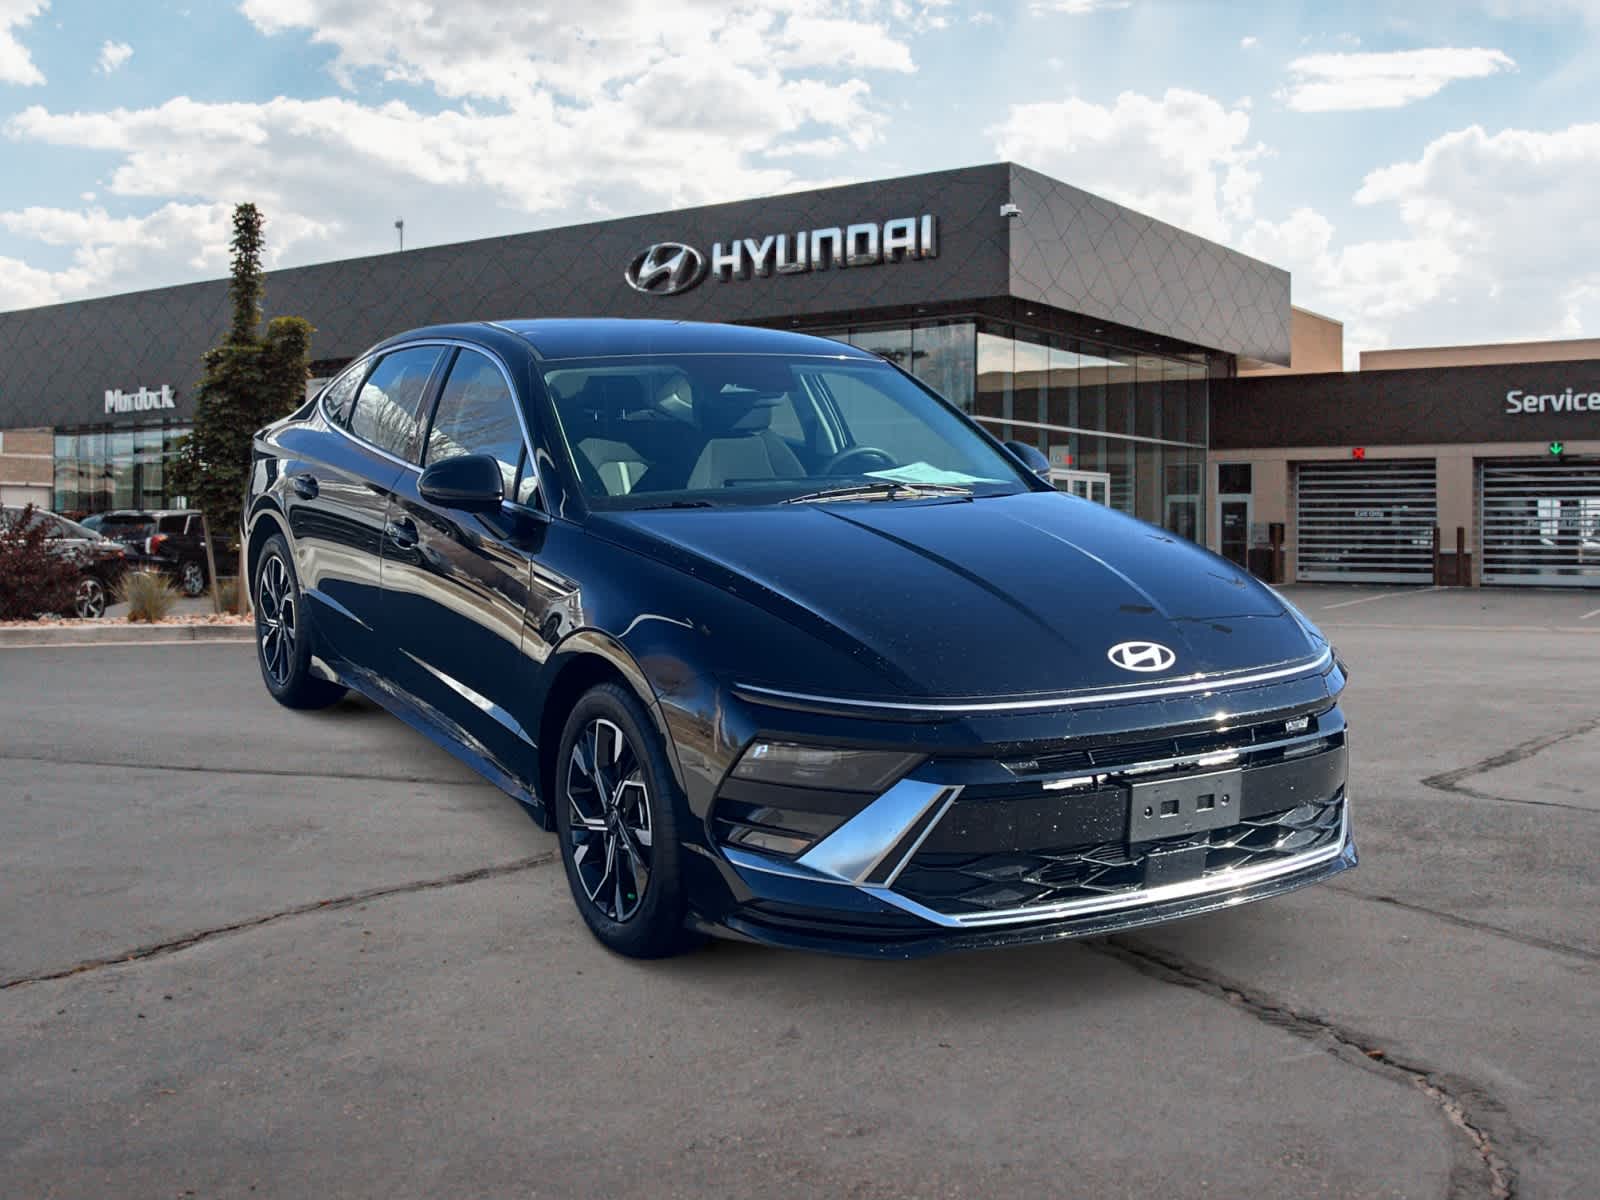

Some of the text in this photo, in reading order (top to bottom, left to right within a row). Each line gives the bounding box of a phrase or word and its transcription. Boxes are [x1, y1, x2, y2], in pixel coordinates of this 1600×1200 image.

[712, 214, 936, 283] HYUNDAI
[104, 384, 176, 414] Murdock
[1505, 387, 1600, 414] Service
